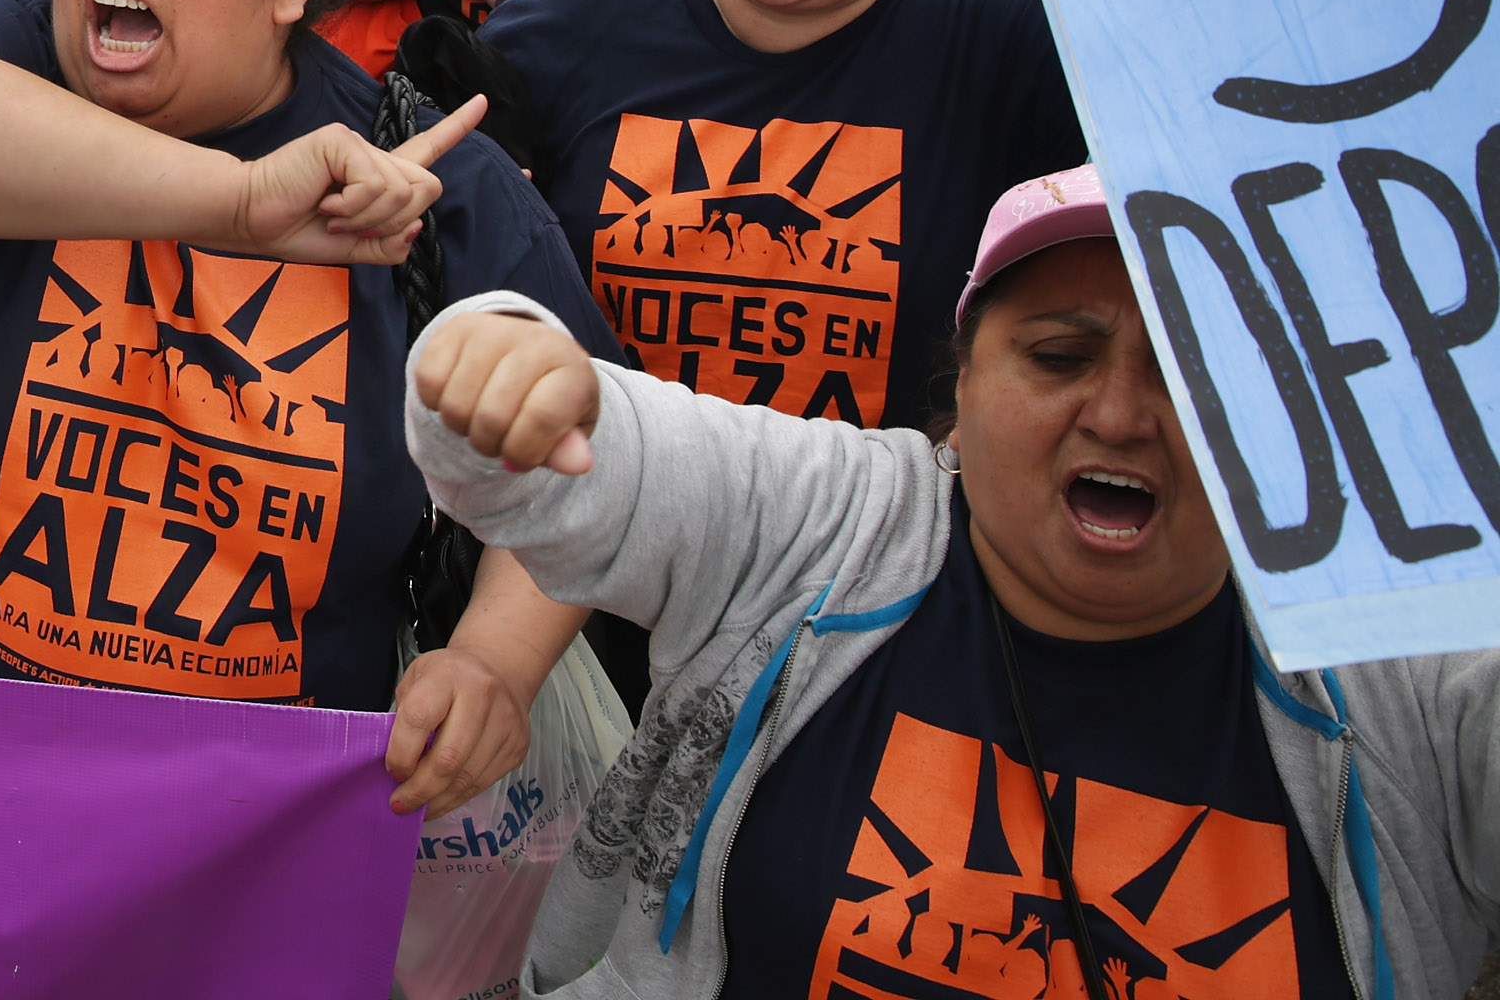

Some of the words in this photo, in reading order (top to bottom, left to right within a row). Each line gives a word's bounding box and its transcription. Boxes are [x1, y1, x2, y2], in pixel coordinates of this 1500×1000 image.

[603, 281, 809, 357] VOCES
[823, 313, 882, 360] EN
[1125, 124, 1500, 574] DEP
[26, 408, 243, 529] VOCES
[257, 484, 326, 543] EN
[37, 619, 82, 652] UNA
[89, 629, 175, 671] NUEVA
[180, 647, 299, 678] ECONOMÍA
[445, 862, 496, 874] PRICE
